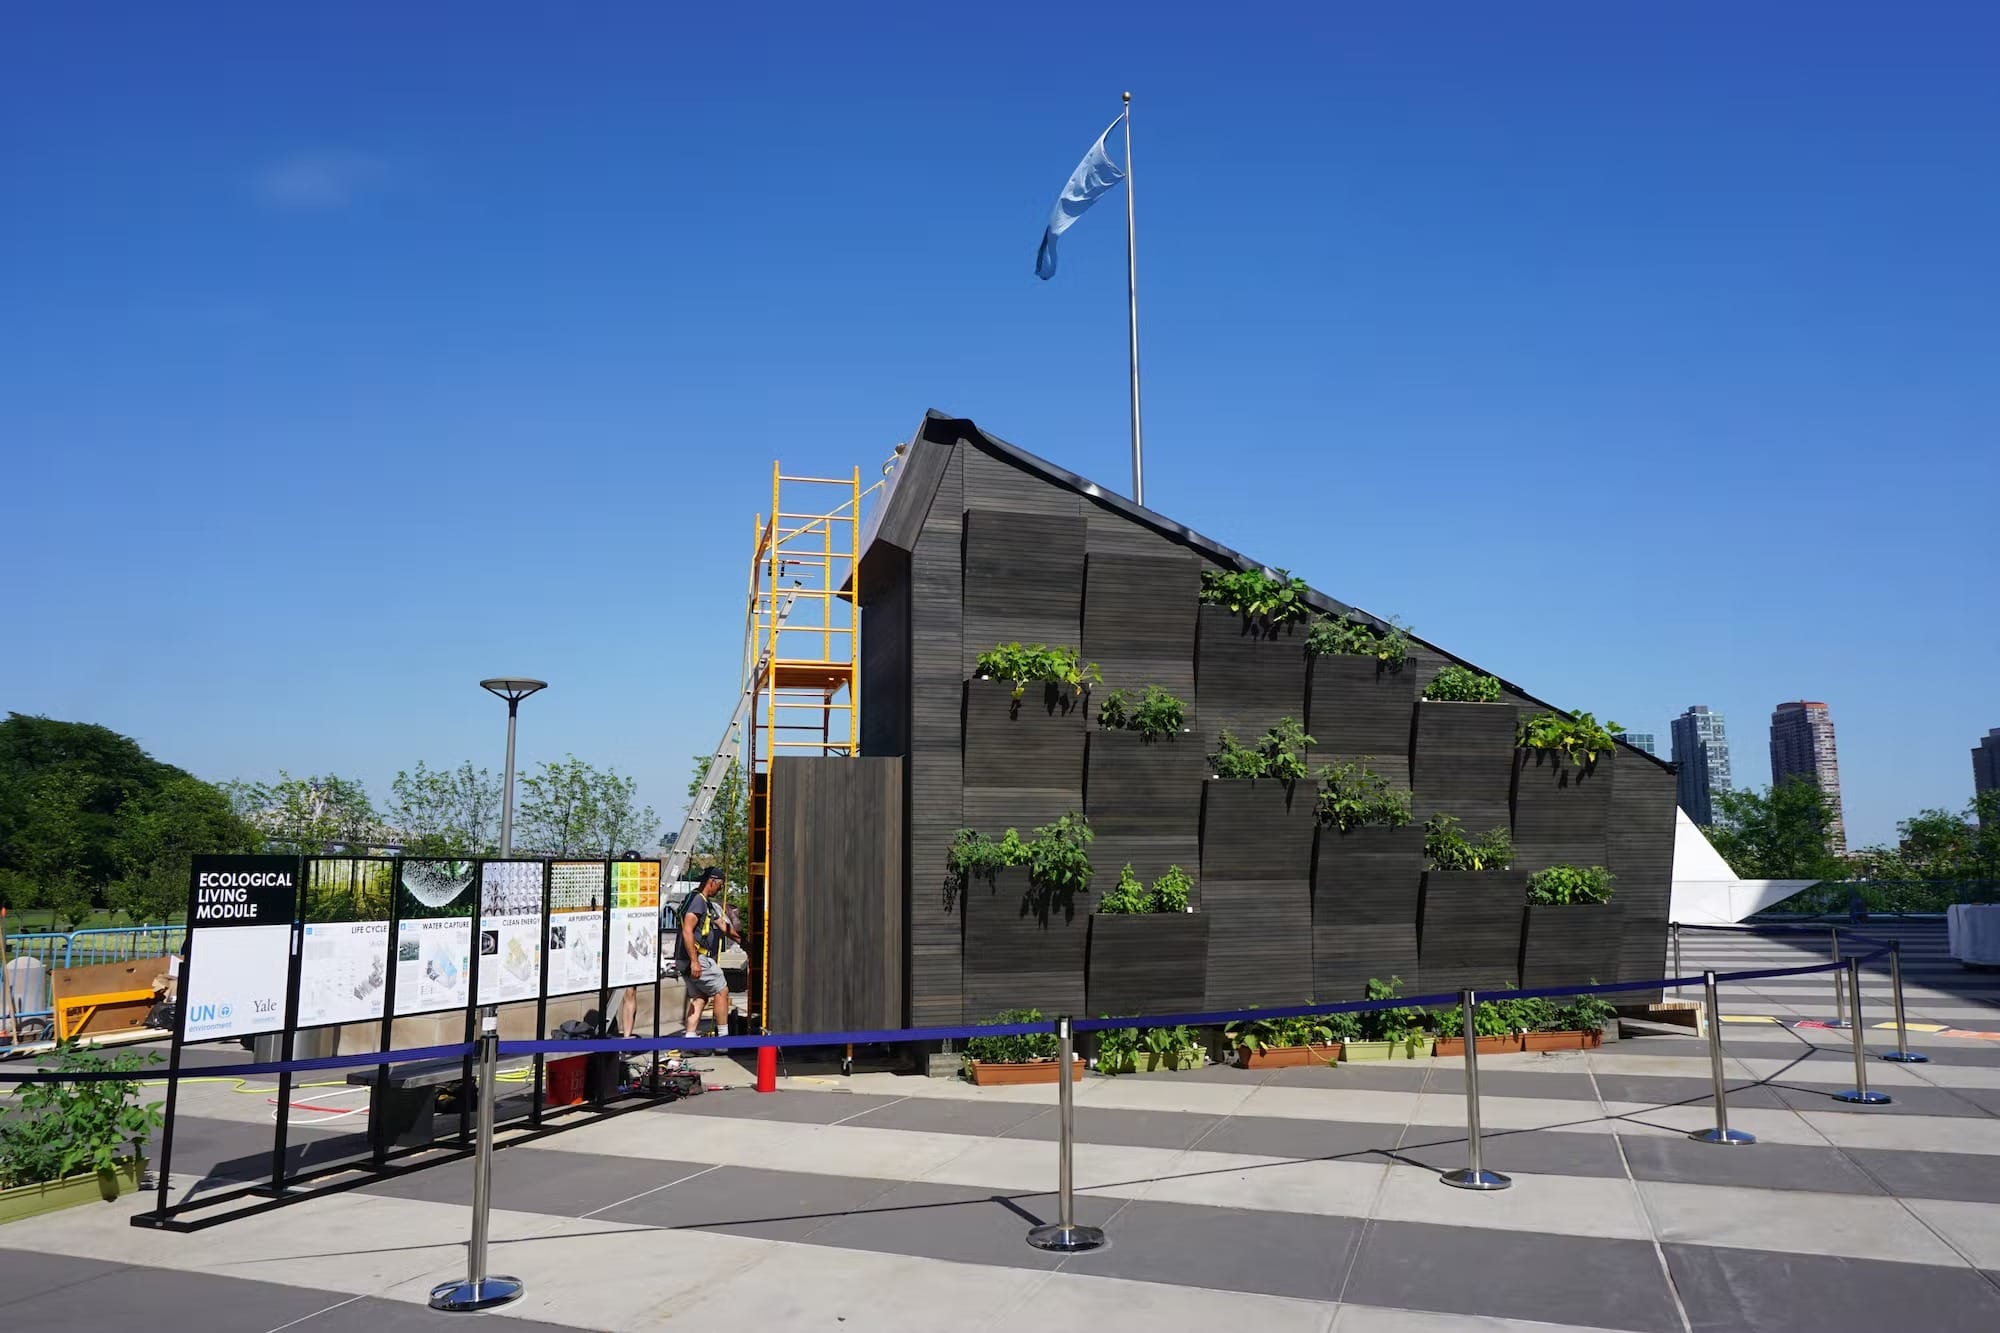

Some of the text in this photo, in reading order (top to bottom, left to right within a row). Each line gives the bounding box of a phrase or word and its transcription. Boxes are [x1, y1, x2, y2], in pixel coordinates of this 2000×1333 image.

[199, 872, 293, 887] ECOLOGICAL
[198, 888, 248, 903] LIVING
[196, 904, 258, 919] MODULE
[351, 925, 388, 934] LIFE CYCLE
[423, 922, 442, 930] WATER
[190, 1004, 216, 1022] UN
[254, 998, 278, 1013] Yale
[188, 1021, 232, 1033] environment
